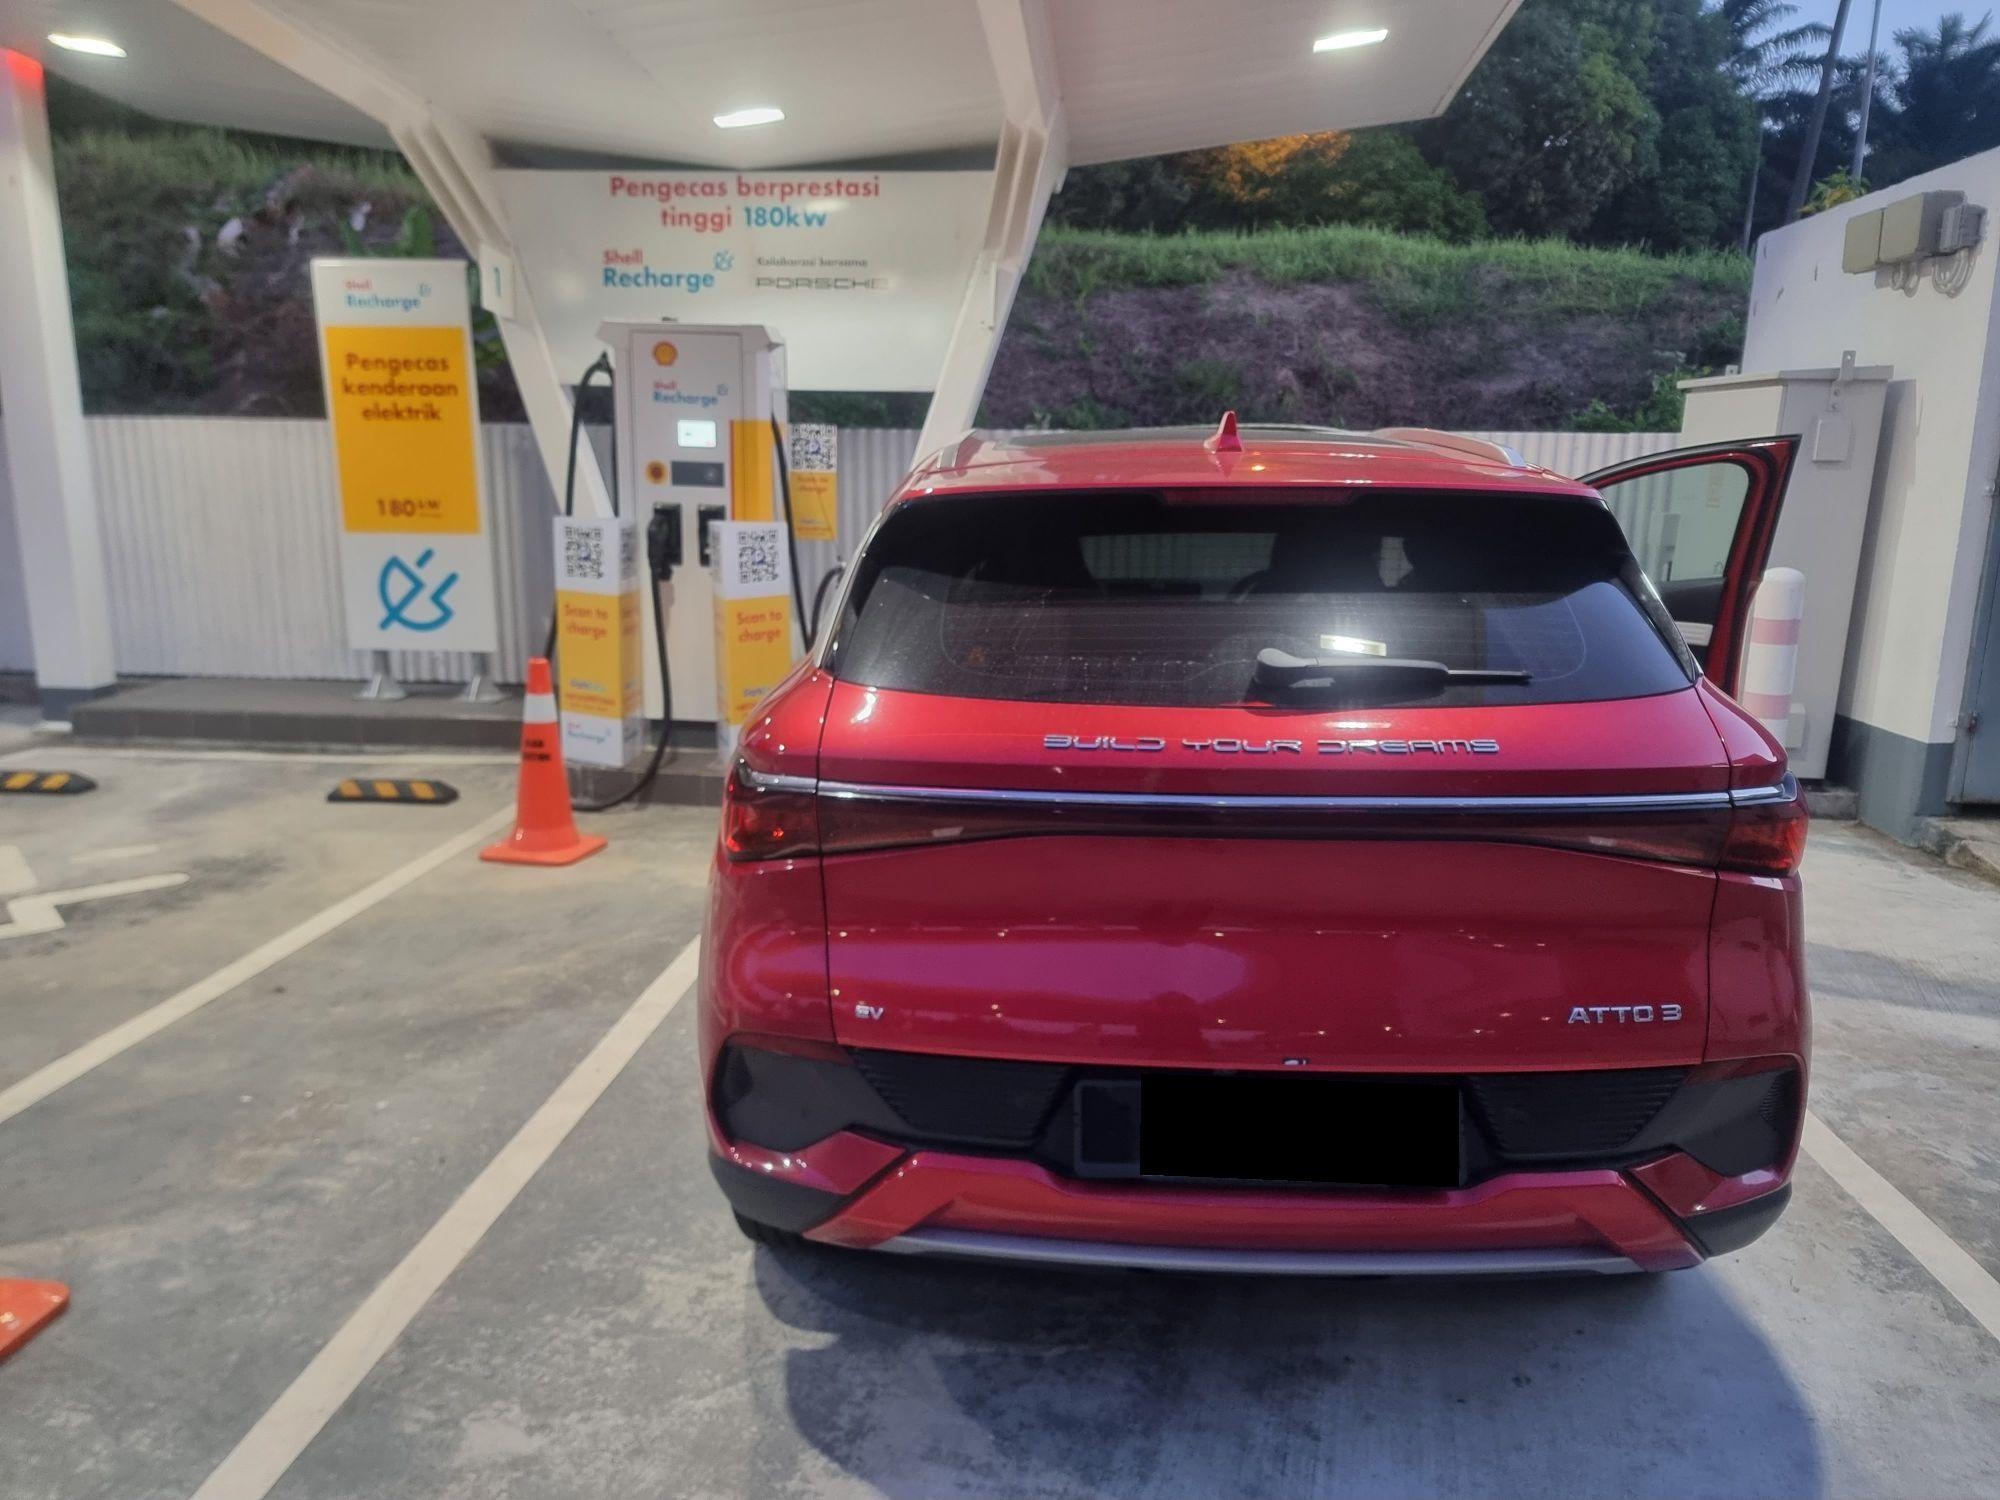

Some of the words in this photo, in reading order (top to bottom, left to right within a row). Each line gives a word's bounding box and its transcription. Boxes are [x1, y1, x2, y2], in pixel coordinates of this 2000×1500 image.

[610, 176, 728, 203] Pengecas
[736, 175, 880, 202] berprestasi
[661, 205, 733, 233] tinggi
[603, 249, 643, 265] Shell
[603, 266, 715, 293] Recharge
[755, 276, 889, 290] PORSCHE
[346, 353, 449, 377] Pengecas
[342, 378, 459, 397] kenderaan
[362, 401, 443, 421] elektrik
[736, 611, 767, 626] Scan
[769, 610, 783, 621] to
[566, 622, 608, 640] charge
[738, 628, 782, 643] charge
[1043, 733, 1166, 751] BUILD
[1181, 738, 1303, 754] YOUR
[1317, 738, 1500, 754] DREAMS
[855, 1004, 884, 1019] EV
[1568, 1005, 1654, 1024] ATTO
[1660, 1004, 1683, 1021] 3
